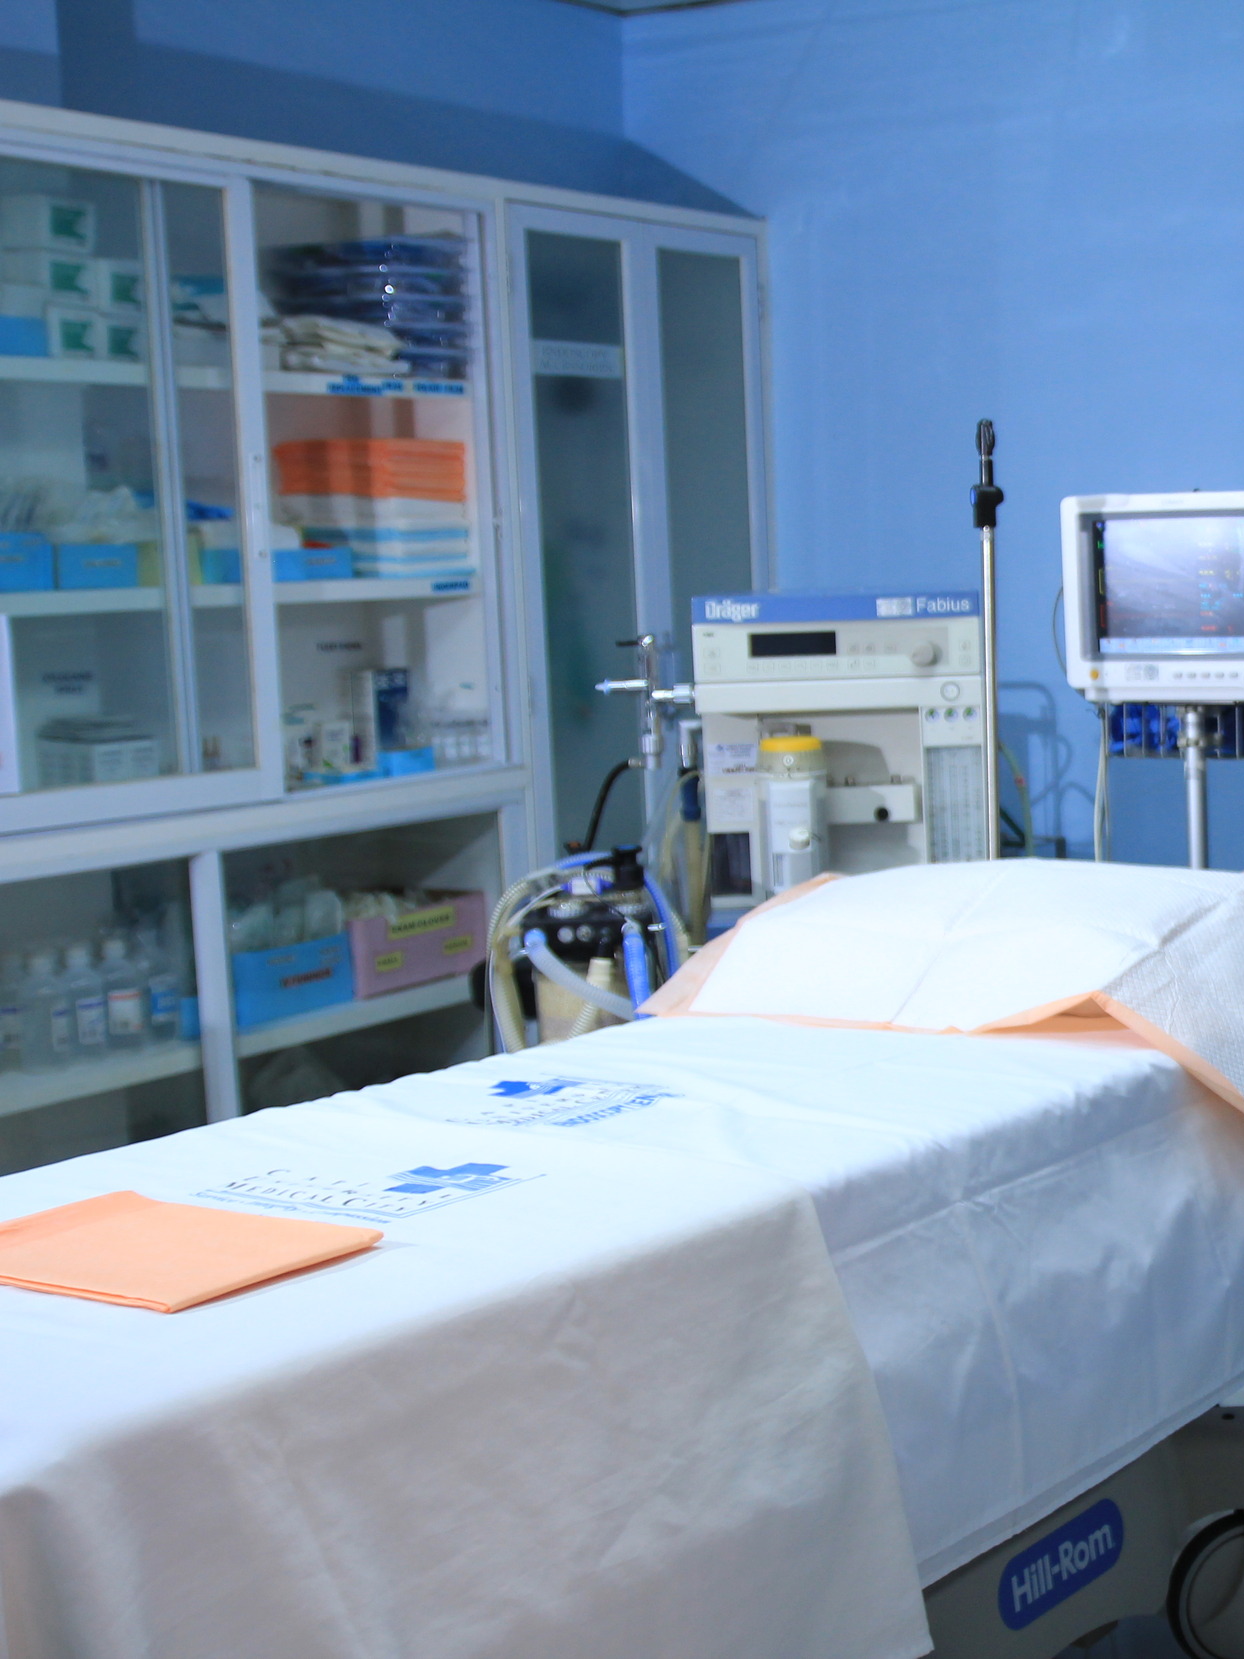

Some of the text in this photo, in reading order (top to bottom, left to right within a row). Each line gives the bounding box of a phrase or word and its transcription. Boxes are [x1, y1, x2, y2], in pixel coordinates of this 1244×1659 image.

[705, 600, 759, 621] Dräger
[917, 597, 970, 613] Fabius
[226, 1182, 334, 1202] MEDICAL
[1011, 1524, 1113, 1613] Hill-Rom
